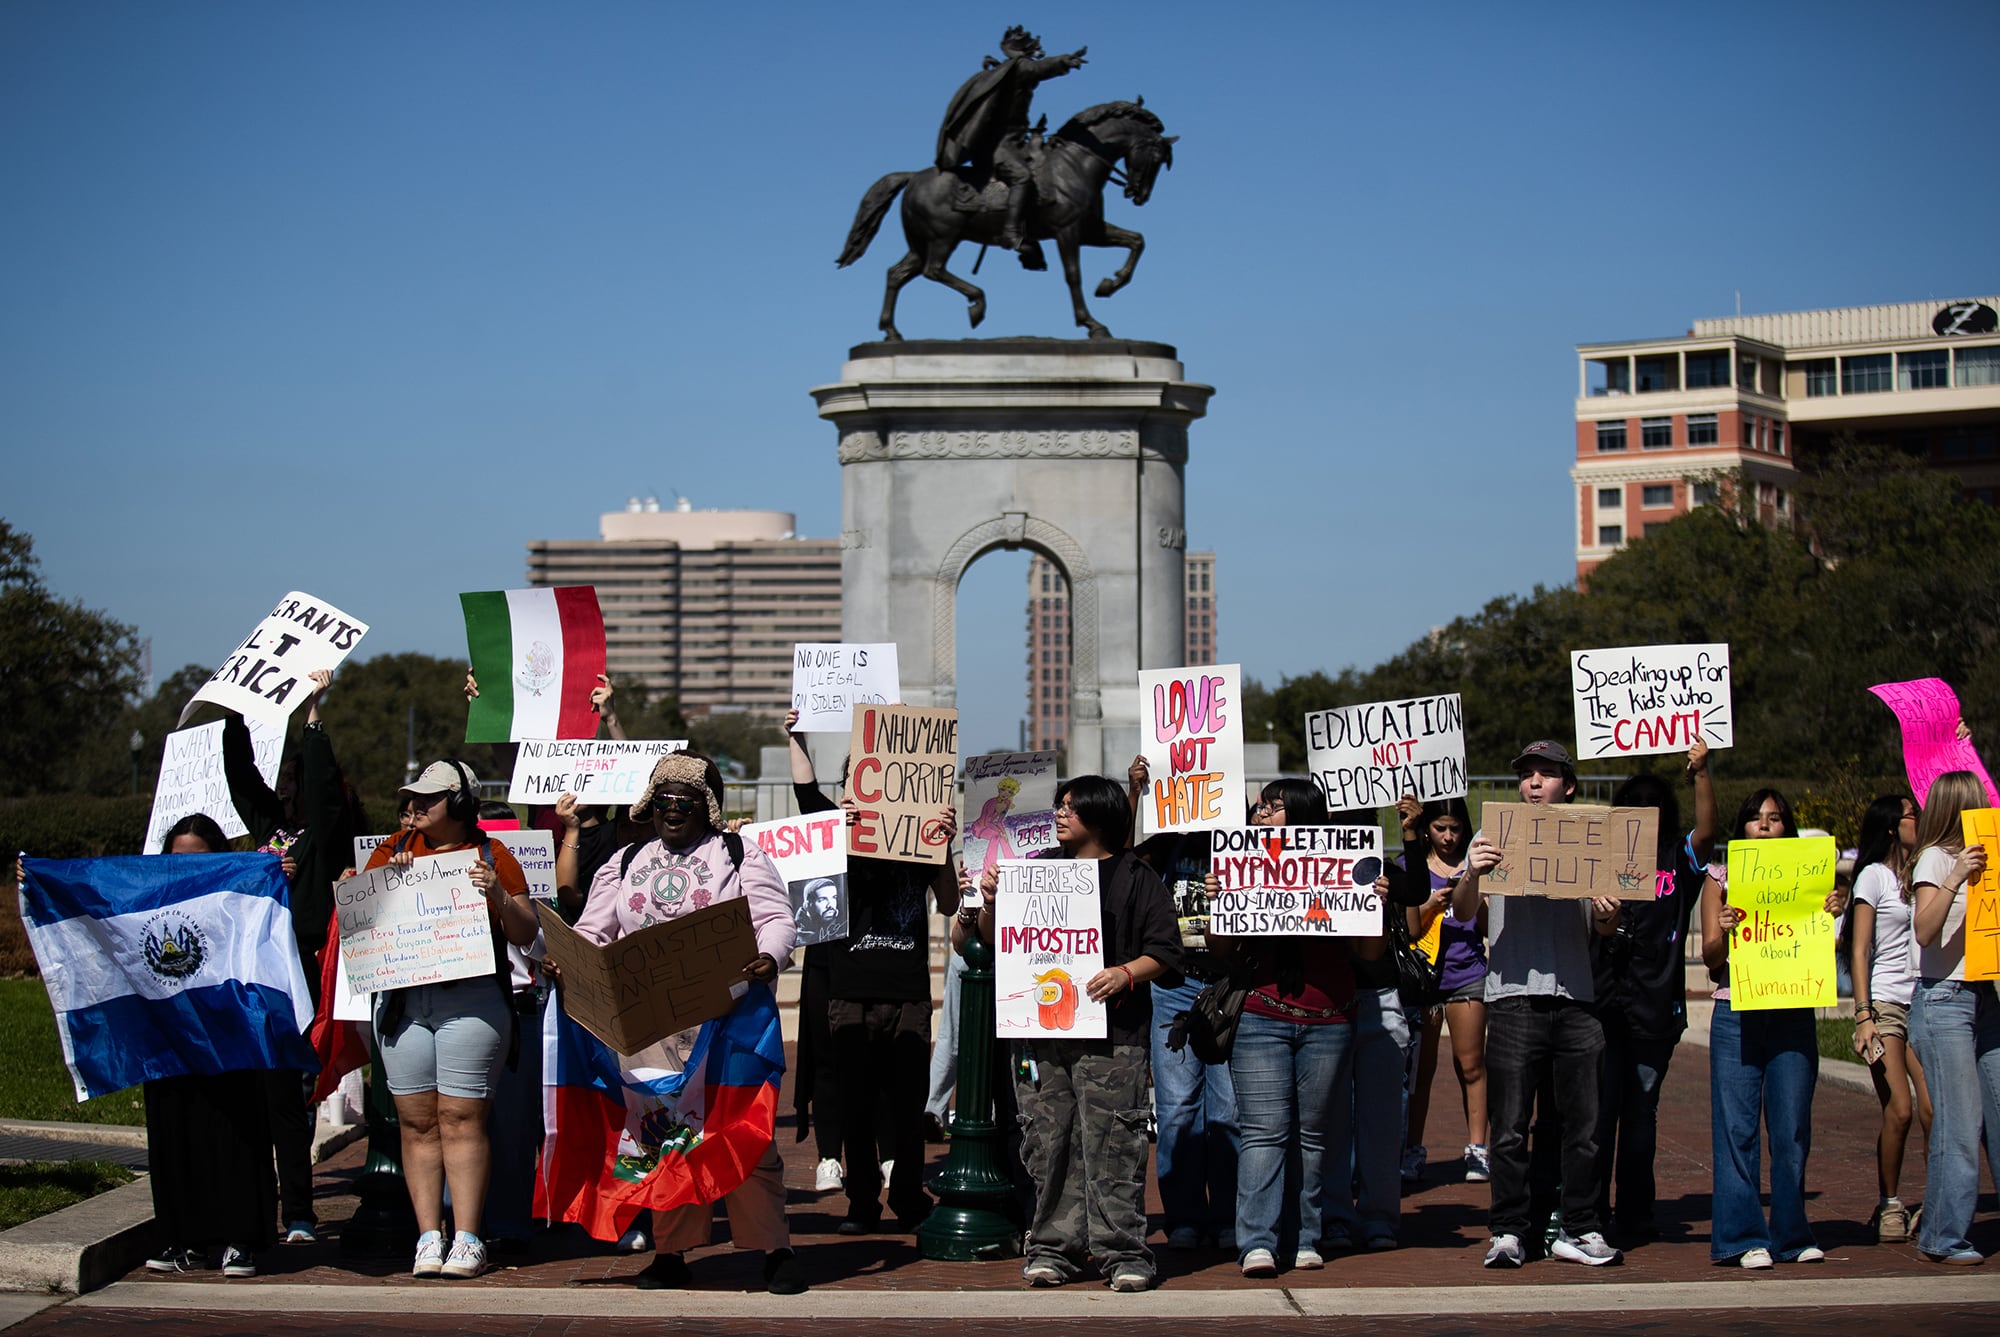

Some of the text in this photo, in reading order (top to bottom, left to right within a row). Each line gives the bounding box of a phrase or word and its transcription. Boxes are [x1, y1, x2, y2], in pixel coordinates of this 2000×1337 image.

[271, 600, 362, 650] GRANTS
[798, 649, 868, 669] NO ONE IS
[1576, 652, 1728, 697] Speaking up for
[211, 655, 298, 705] ERICA
[807, 671, 863, 687] ILLEGAL
[812, 693, 846, 711] STOLEN
[1154, 675, 1226, 743] LOVE
[1582, 696, 1618, 720] The
[1671, 686, 1712, 706] who
[863, 709, 958, 754] INHUMANE
[1309, 697, 1462, 751] EDUCATION
[171, 725, 214, 762] WHEN
[523, 742, 543, 758] NO
[547, 742, 596, 758] DECENT
[597, 743, 642, 756] HUMAN
[645, 743, 668, 756] HAS
[1170, 737, 1216, 776] NOT
[1372, 739, 1418, 767] NOT
[575, 759, 617, 771] HEART
[204, 780, 228, 803] YOU
[525, 770, 640, 794] MADE OF ICE
[1311, 756, 1466, 809] DEPORTATION
[1155, 772, 1224, 829] HATE
[852, 810, 933, 859] EVIL
[1017, 824, 1052, 847] ICE
[1281, 828, 1319, 851] LET
[1324, 828, 1375, 850] THEM
[1529, 818, 1603, 845] ICE
[1001, 863, 1094, 895] THERE'S
[1213, 856, 1354, 888] HYPNOTIZE
[1530, 857, 1601, 889] OUT
[1731, 848, 1828, 883] This isn't
[336, 859, 474, 906] God Bless Americ
[1756, 882, 1800, 904] about
[343, 908, 374, 931] Chile
[416, 892, 453, 917] Uruguay
[450, 887, 487, 912] Paraguay
[1022, 895, 1069, 928] AN
[1216, 892, 1248, 912] YOU
[1256, 892, 1296, 910] INTO
[1300, 891, 1377, 912] THINKING
[371, 928, 394, 941] Peru
[397, 924, 433, 936] Ecuador
[1213, 913, 1338, 933] THIS IS NORMAL
[1805, 911, 1831, 935] it's
[343, 941, 394, 960] Venezuela
[396, 937, 432, 950] Guyana
[434, 930, 460, 941] Panama
[597, 907, 751, 980] HOUSTON
[1001, 926, 1100, 955] IMPOSTER
[1760, 940, 1801, 959] about
[376, 967, 396, 977] Cuba
[384, 953, 419, 965] Honduras
[620, 935, 739, 1003] MELT
[354, 981, 387, 995] United
[411, 971, 442, 983] Canada
[1735, 964, 1825, 1003] Humanity
